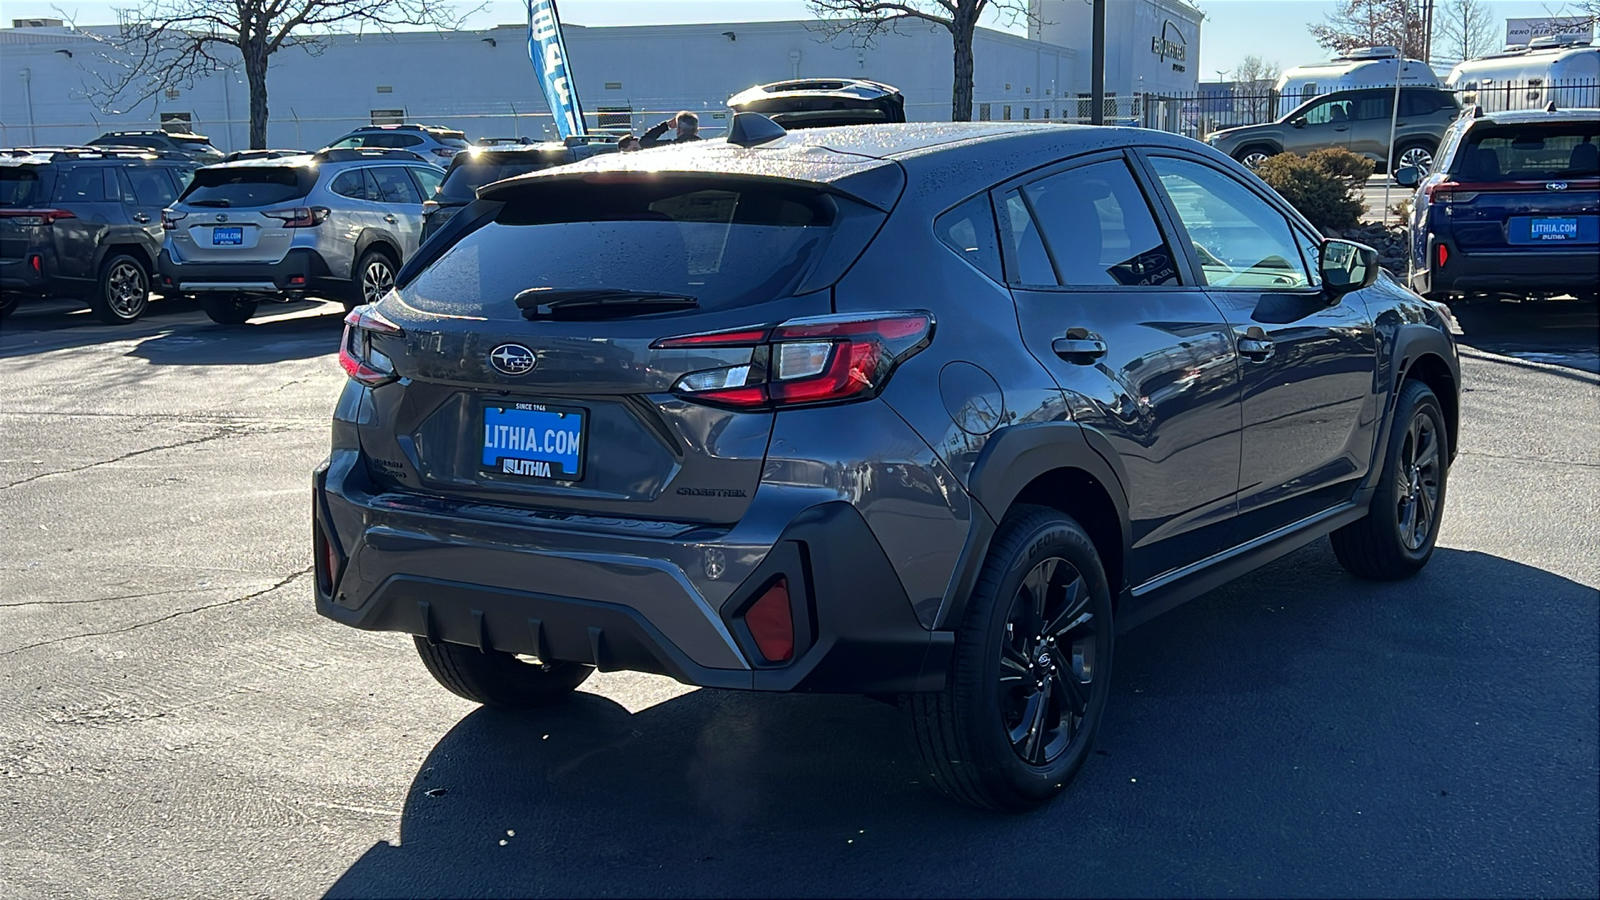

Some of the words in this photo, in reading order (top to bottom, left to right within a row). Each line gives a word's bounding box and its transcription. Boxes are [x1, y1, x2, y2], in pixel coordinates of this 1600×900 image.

[1531, 224, 1577, 233] LITHIA.COM
[515, 403, 533, 411] SINCE
[533, 404, 546, 412] 1946
[484, 424, 581, 456] LITHIA.COM
[513, 459, 552, 478] LITHIA
[676, 487, 748, 498] CROSSTREK
